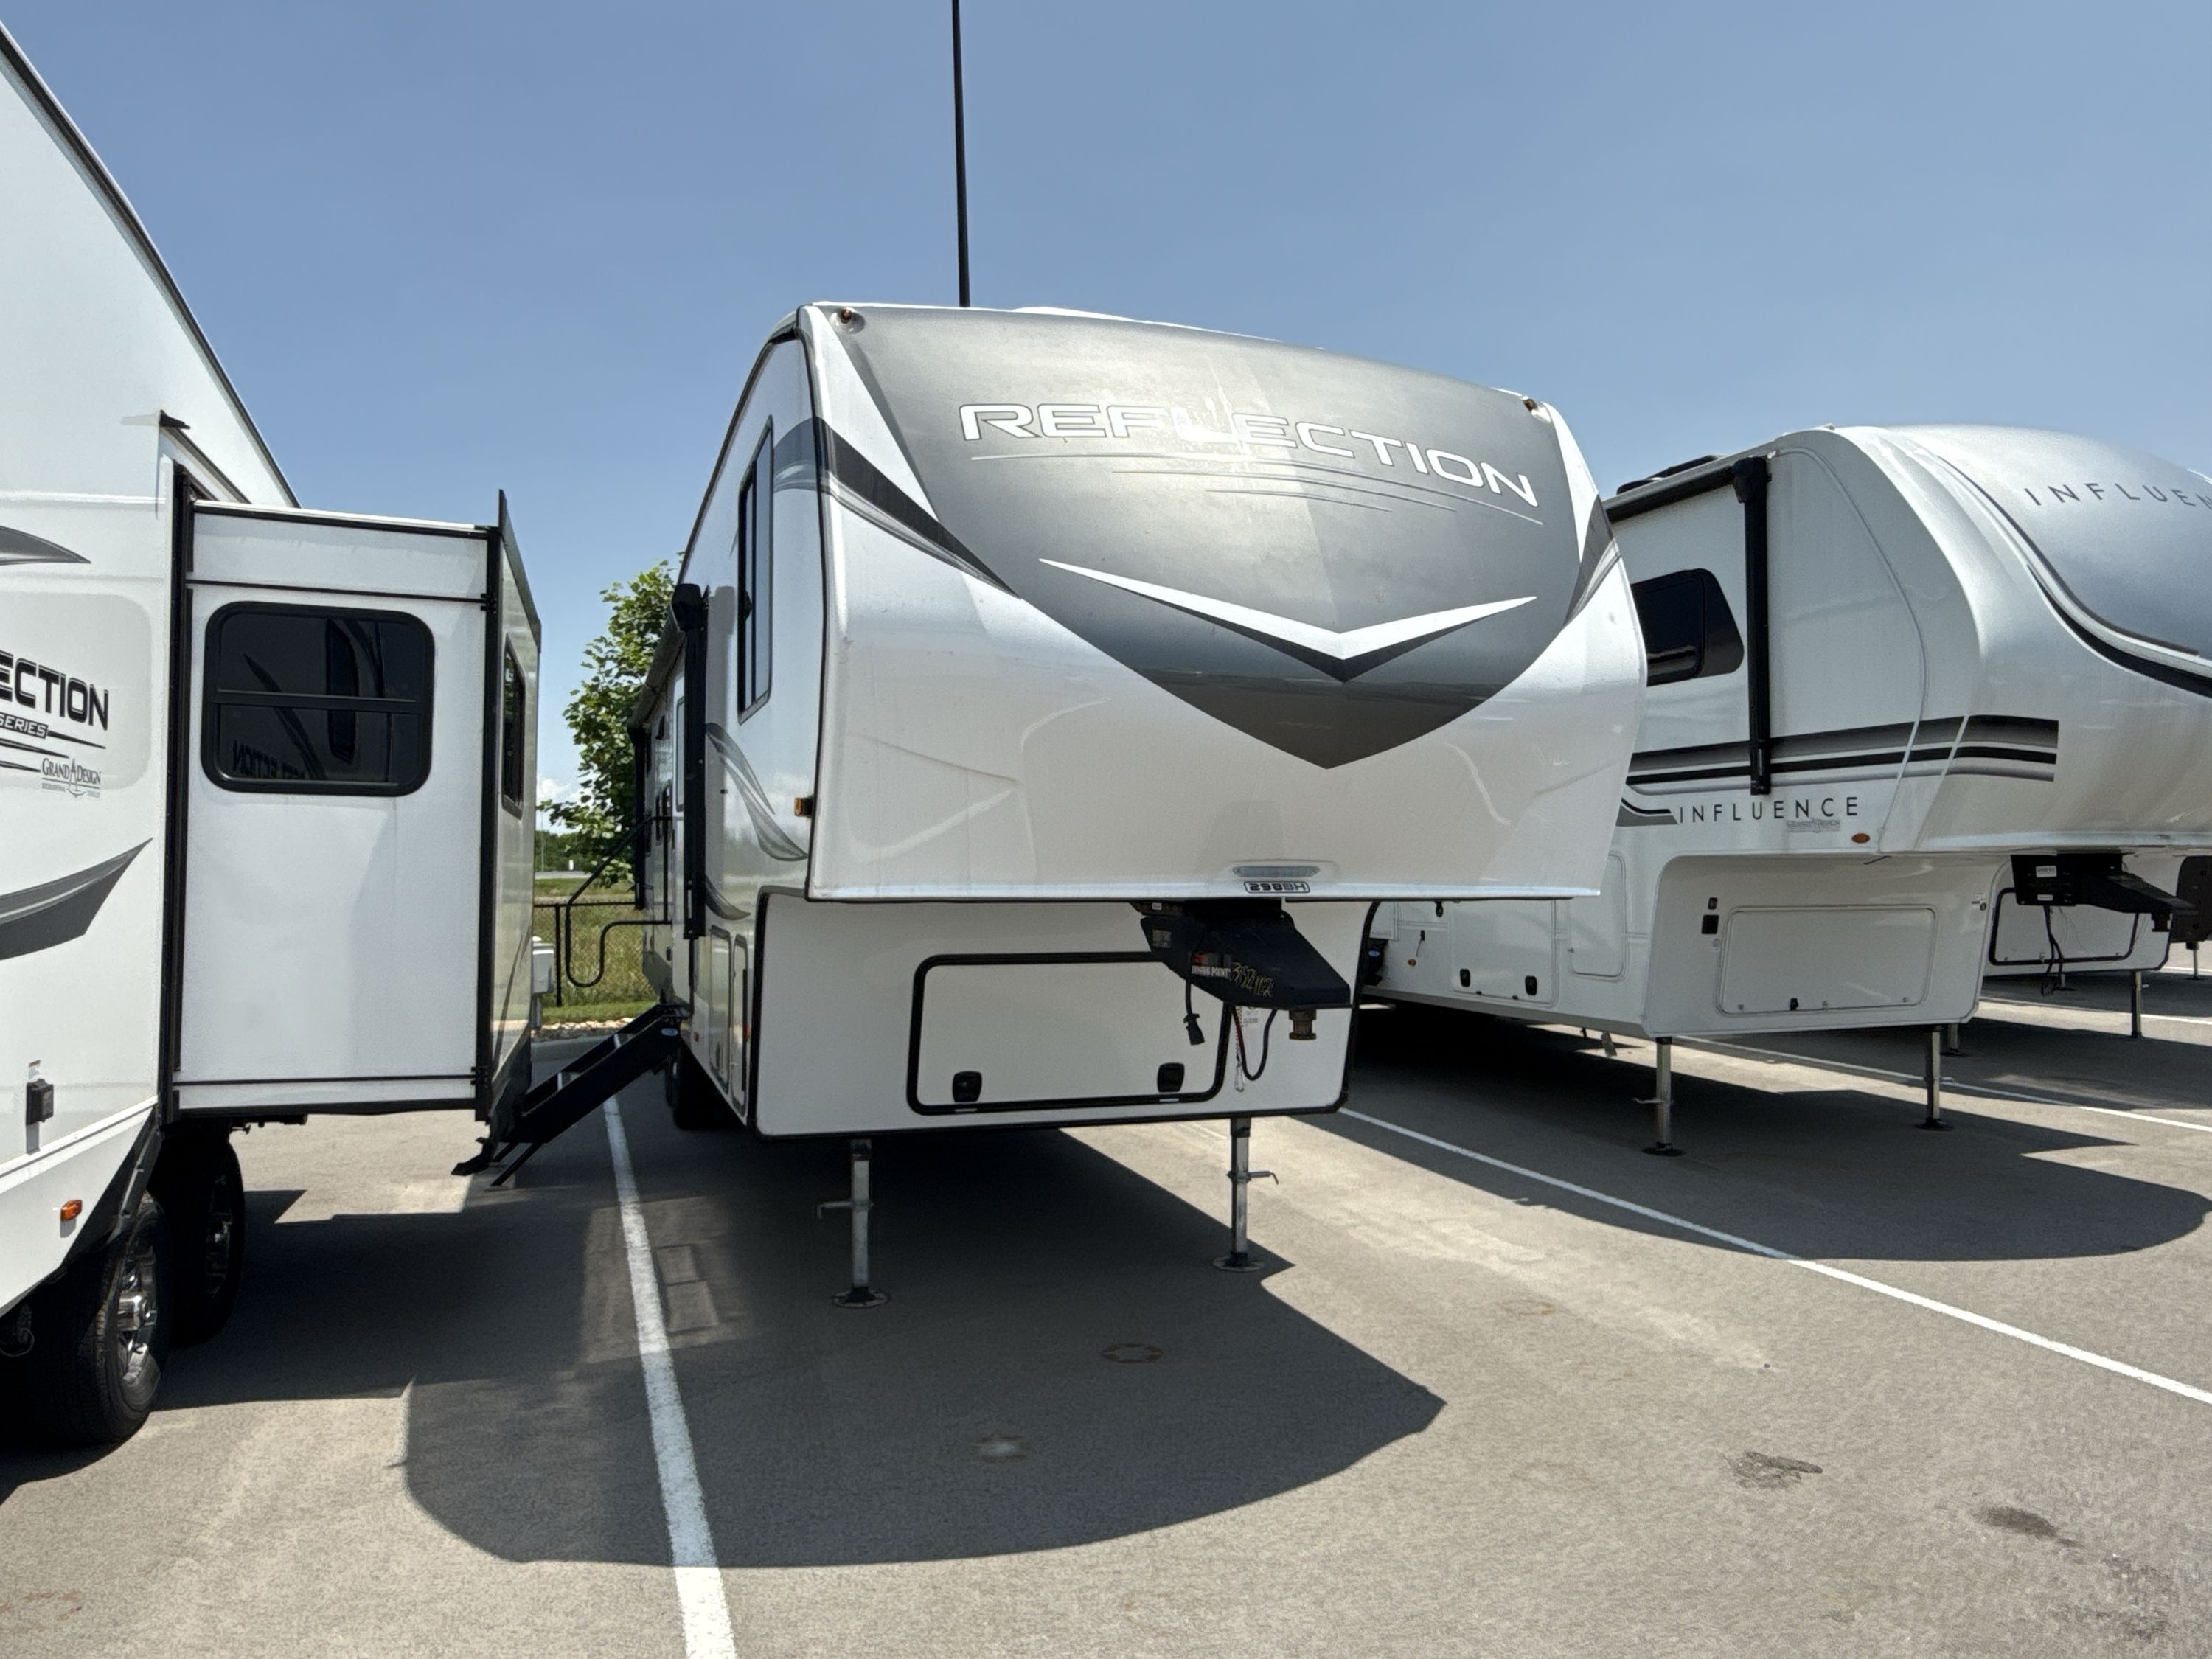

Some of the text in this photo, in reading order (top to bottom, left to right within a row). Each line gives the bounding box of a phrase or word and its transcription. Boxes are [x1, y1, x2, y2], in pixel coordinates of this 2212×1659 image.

[960, 403, 1540, 508] REFLECTION
[42, 757, 70, 779] GRAND
[1679, 796, 1858, 823] INFLUENCE
